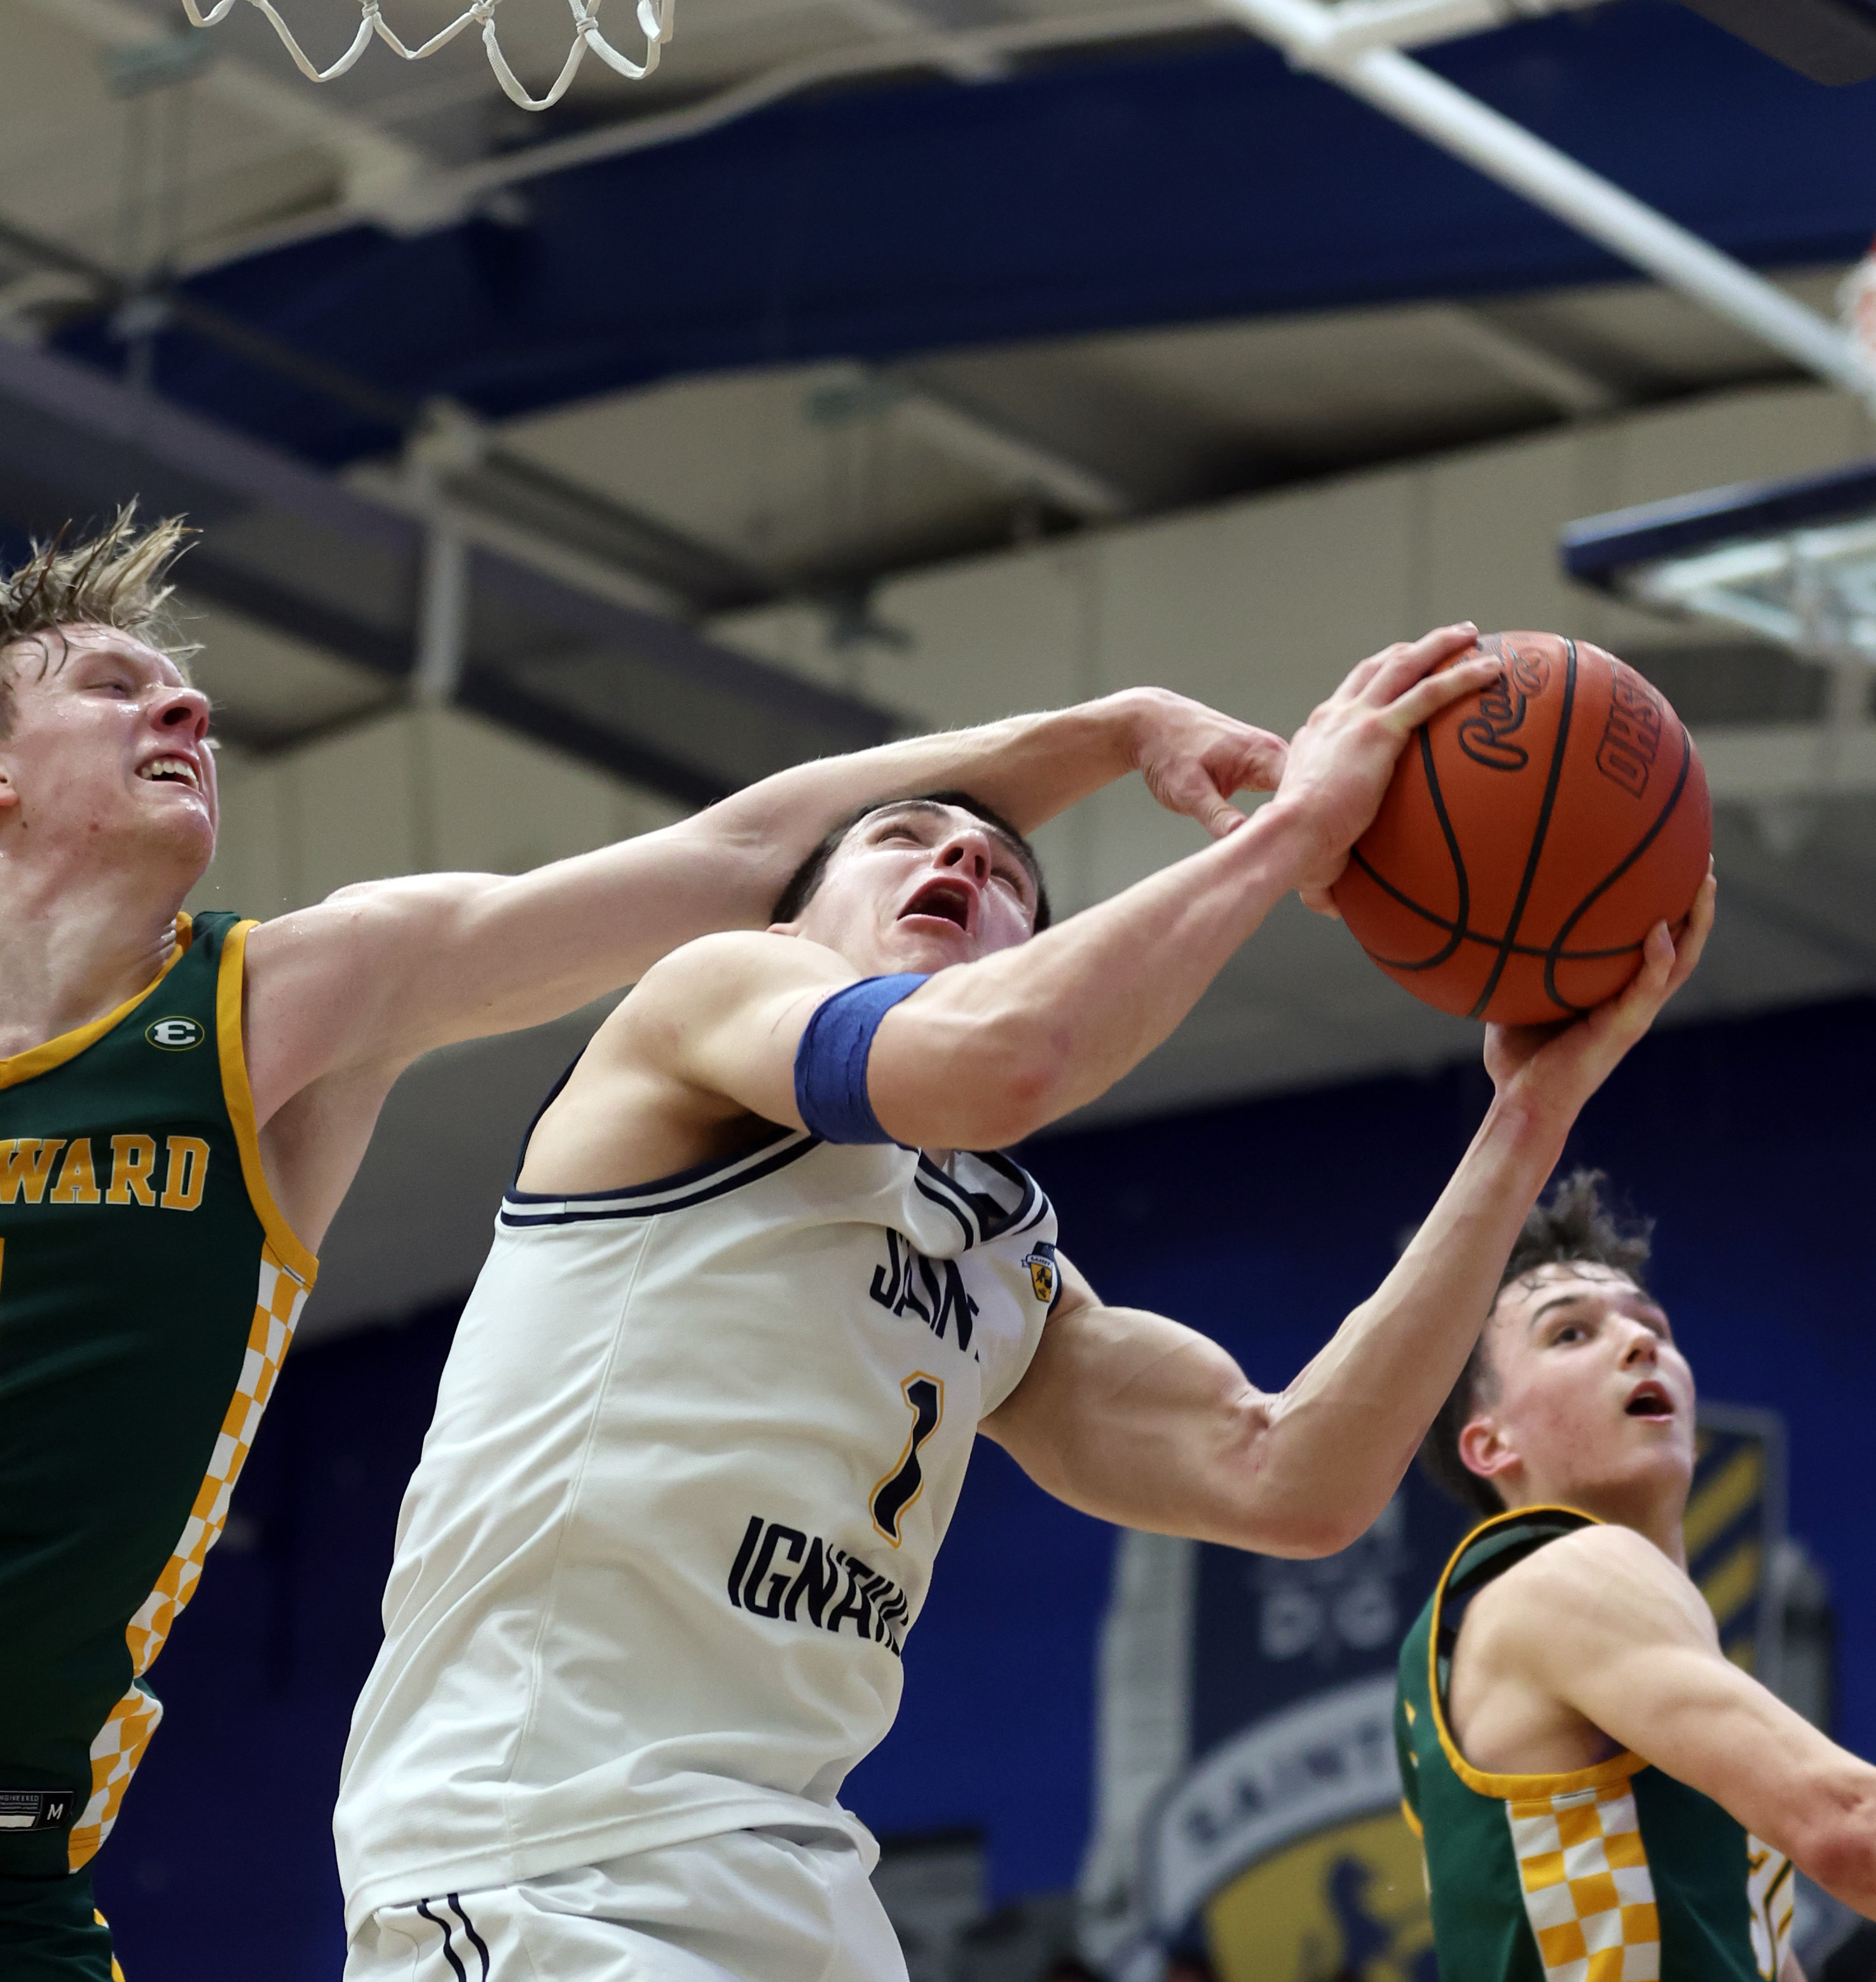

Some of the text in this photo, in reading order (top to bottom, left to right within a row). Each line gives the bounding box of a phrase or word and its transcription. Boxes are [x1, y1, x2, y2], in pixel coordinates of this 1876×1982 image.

[154, 1020, 196, 1045] E
[869, 1370, 945, 1550] 1
[46, 1803, 64, 1820] M
